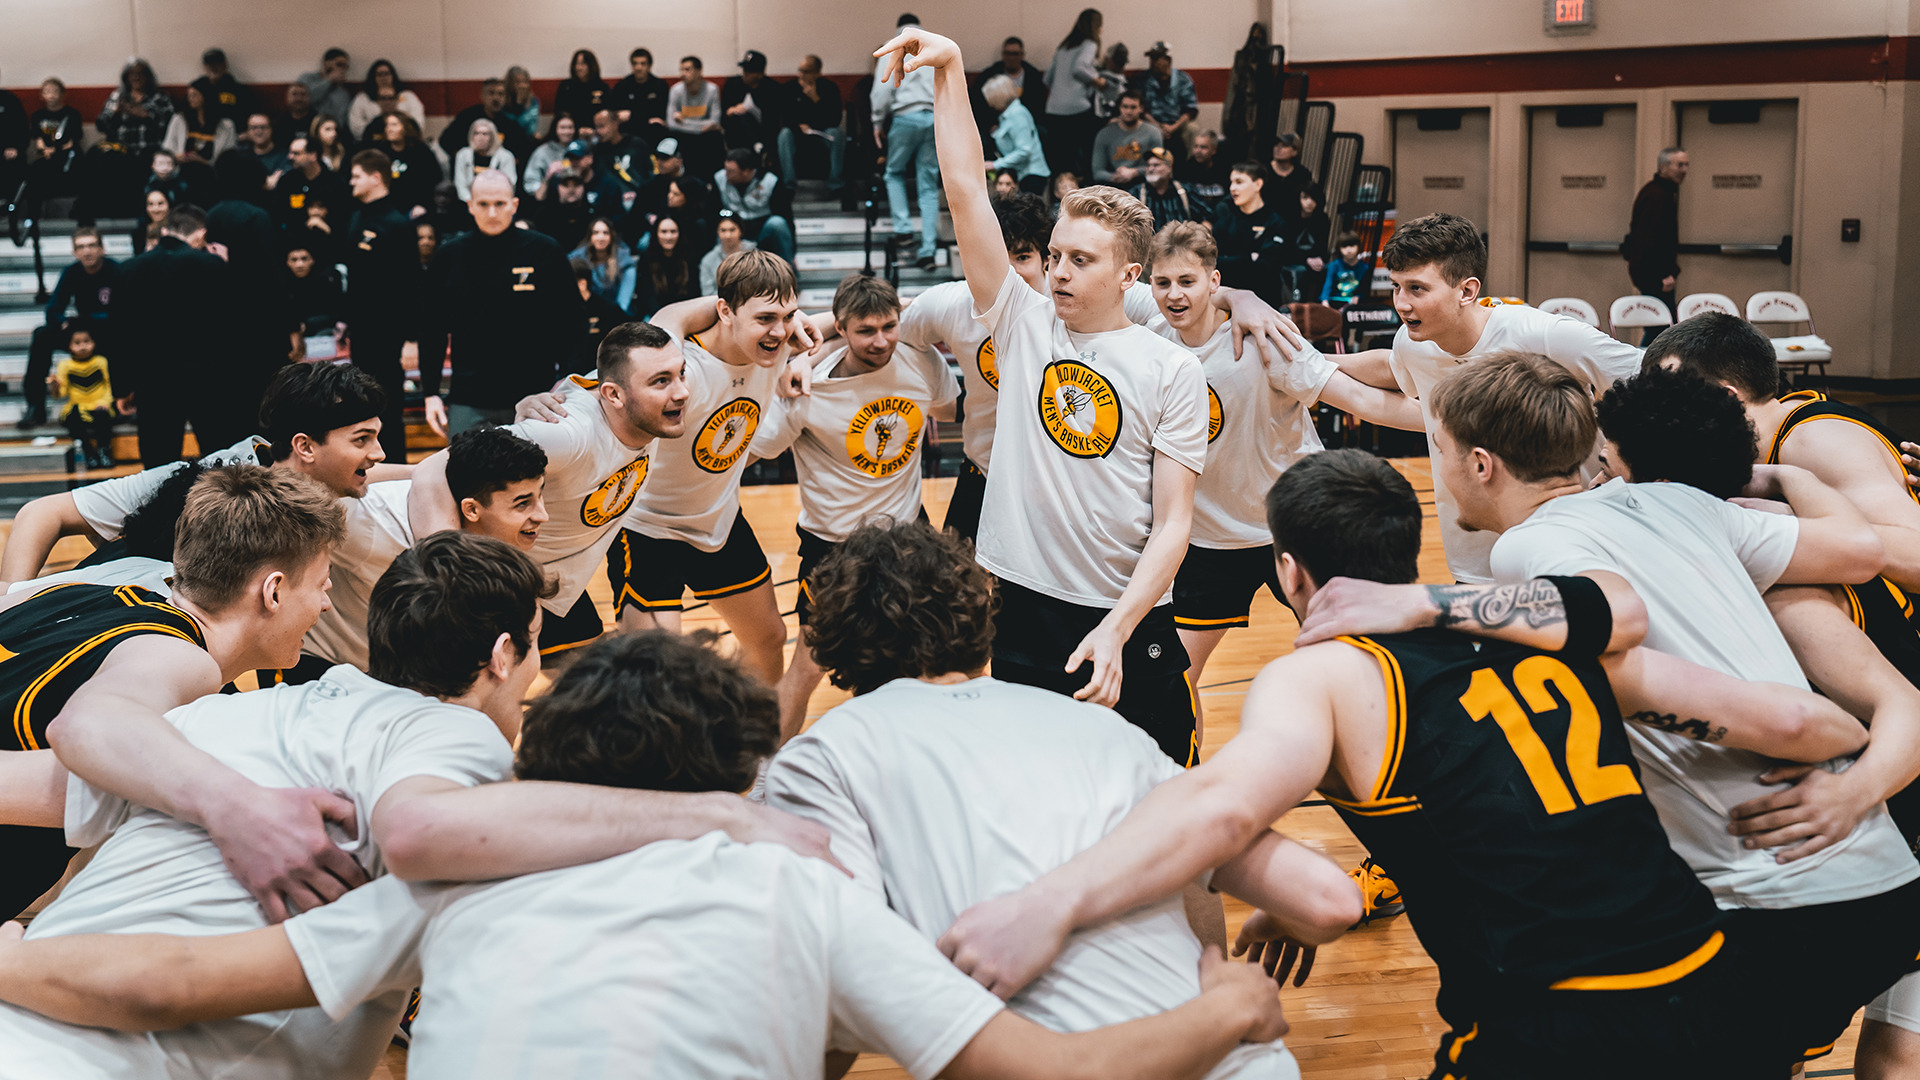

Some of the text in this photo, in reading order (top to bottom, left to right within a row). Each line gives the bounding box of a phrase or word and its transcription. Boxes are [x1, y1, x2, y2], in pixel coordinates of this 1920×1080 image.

[1556, 0, 1584, 22] EXIT
[1347, 310, 1392, 322] BETHANY
[1055, 367, 1113, 407] LLOWJACKET
[850, 398, 915, 434] YELLOWJACKET
[1044, 396, 1112, 452] MEN'S BASKEALL
[851, 453, 879, 474] MEN'S
[1458, 655, 1642, 815] 12
